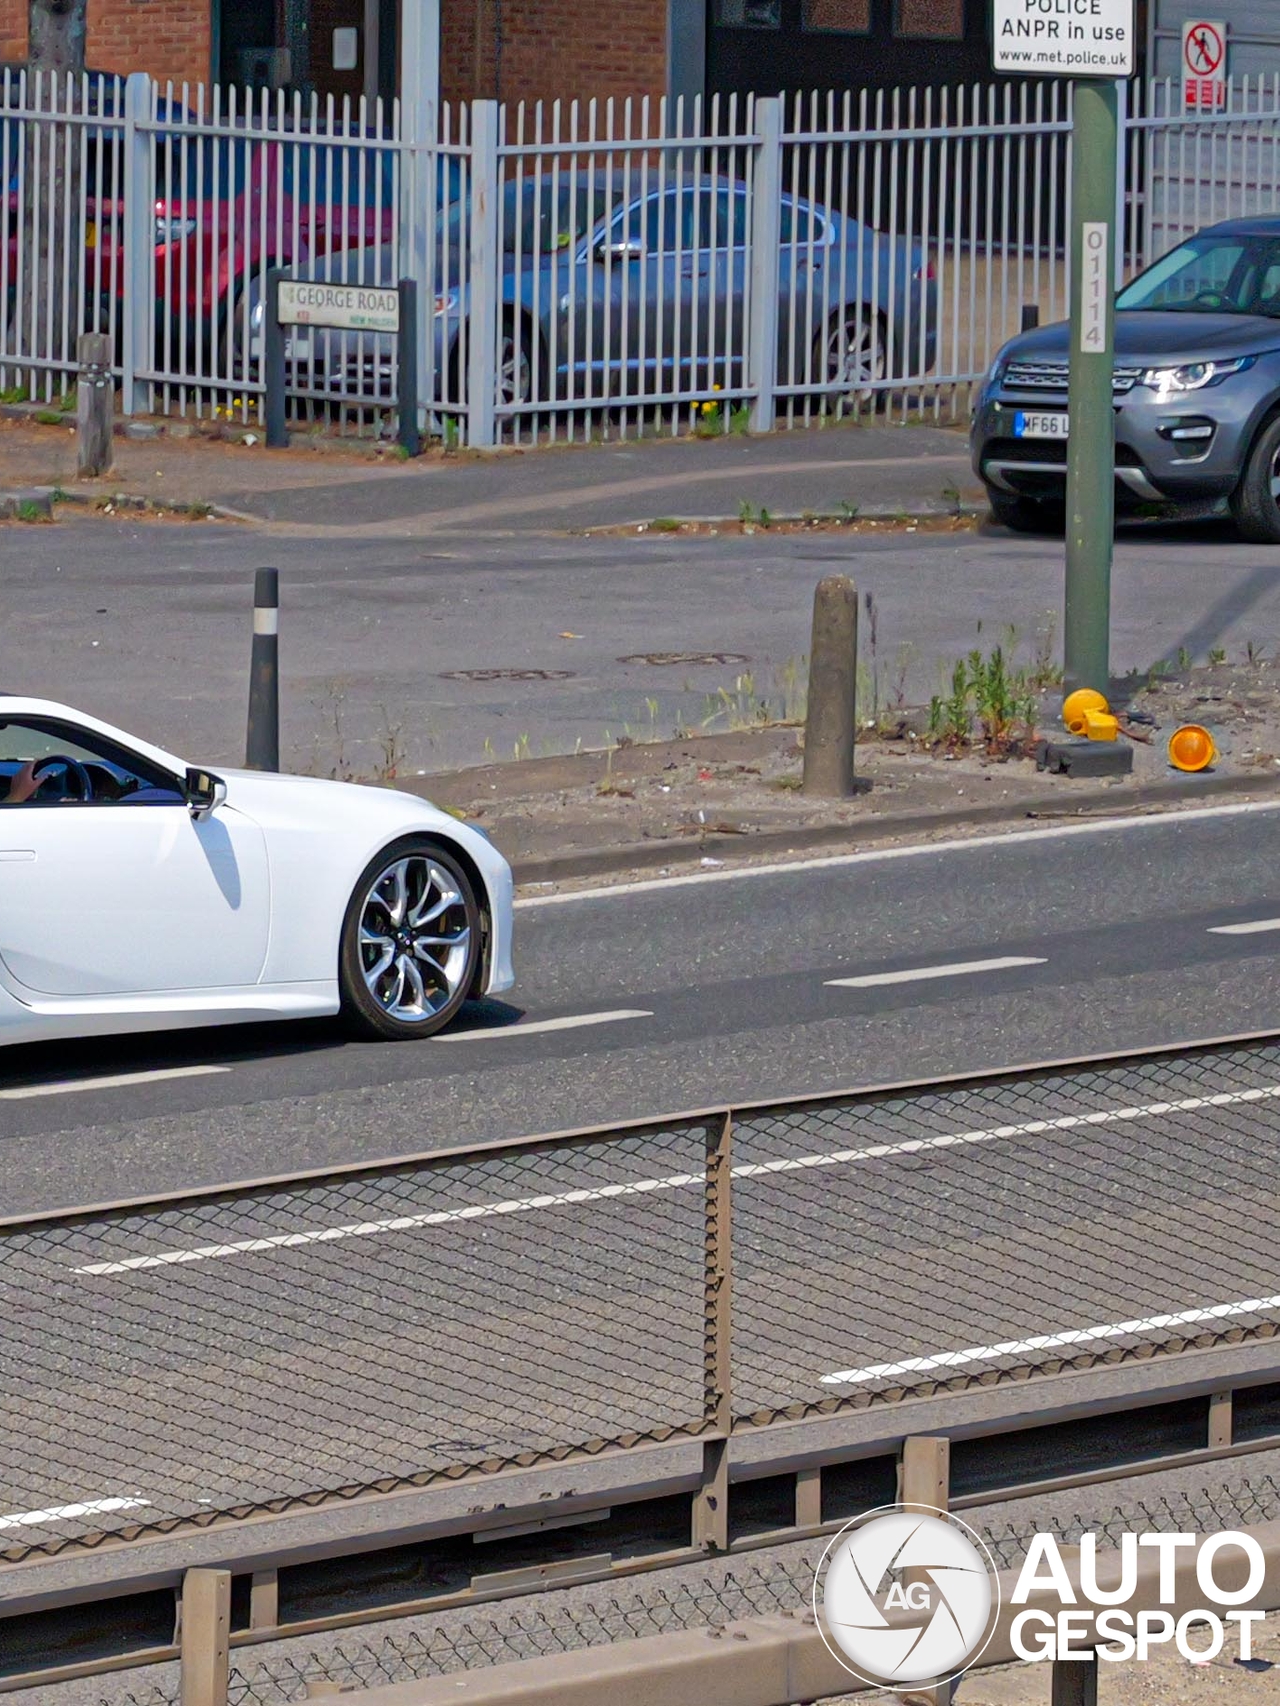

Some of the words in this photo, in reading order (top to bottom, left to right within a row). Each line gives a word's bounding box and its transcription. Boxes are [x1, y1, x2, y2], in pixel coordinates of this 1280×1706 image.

[1025, 0, 1102, 15] POLICE
[1001, 18, 1060, 38] ANPR
[1068, 21, 1084, 40] in
[1092, 26, 1126, 41] use
[999, 50, 1127, 66] www.met.police.uk
[1086, 230, 1103, 345] 01114
[296, 287, 354, 309] GEORGE
[357, 291, 397, 312] ROAD
